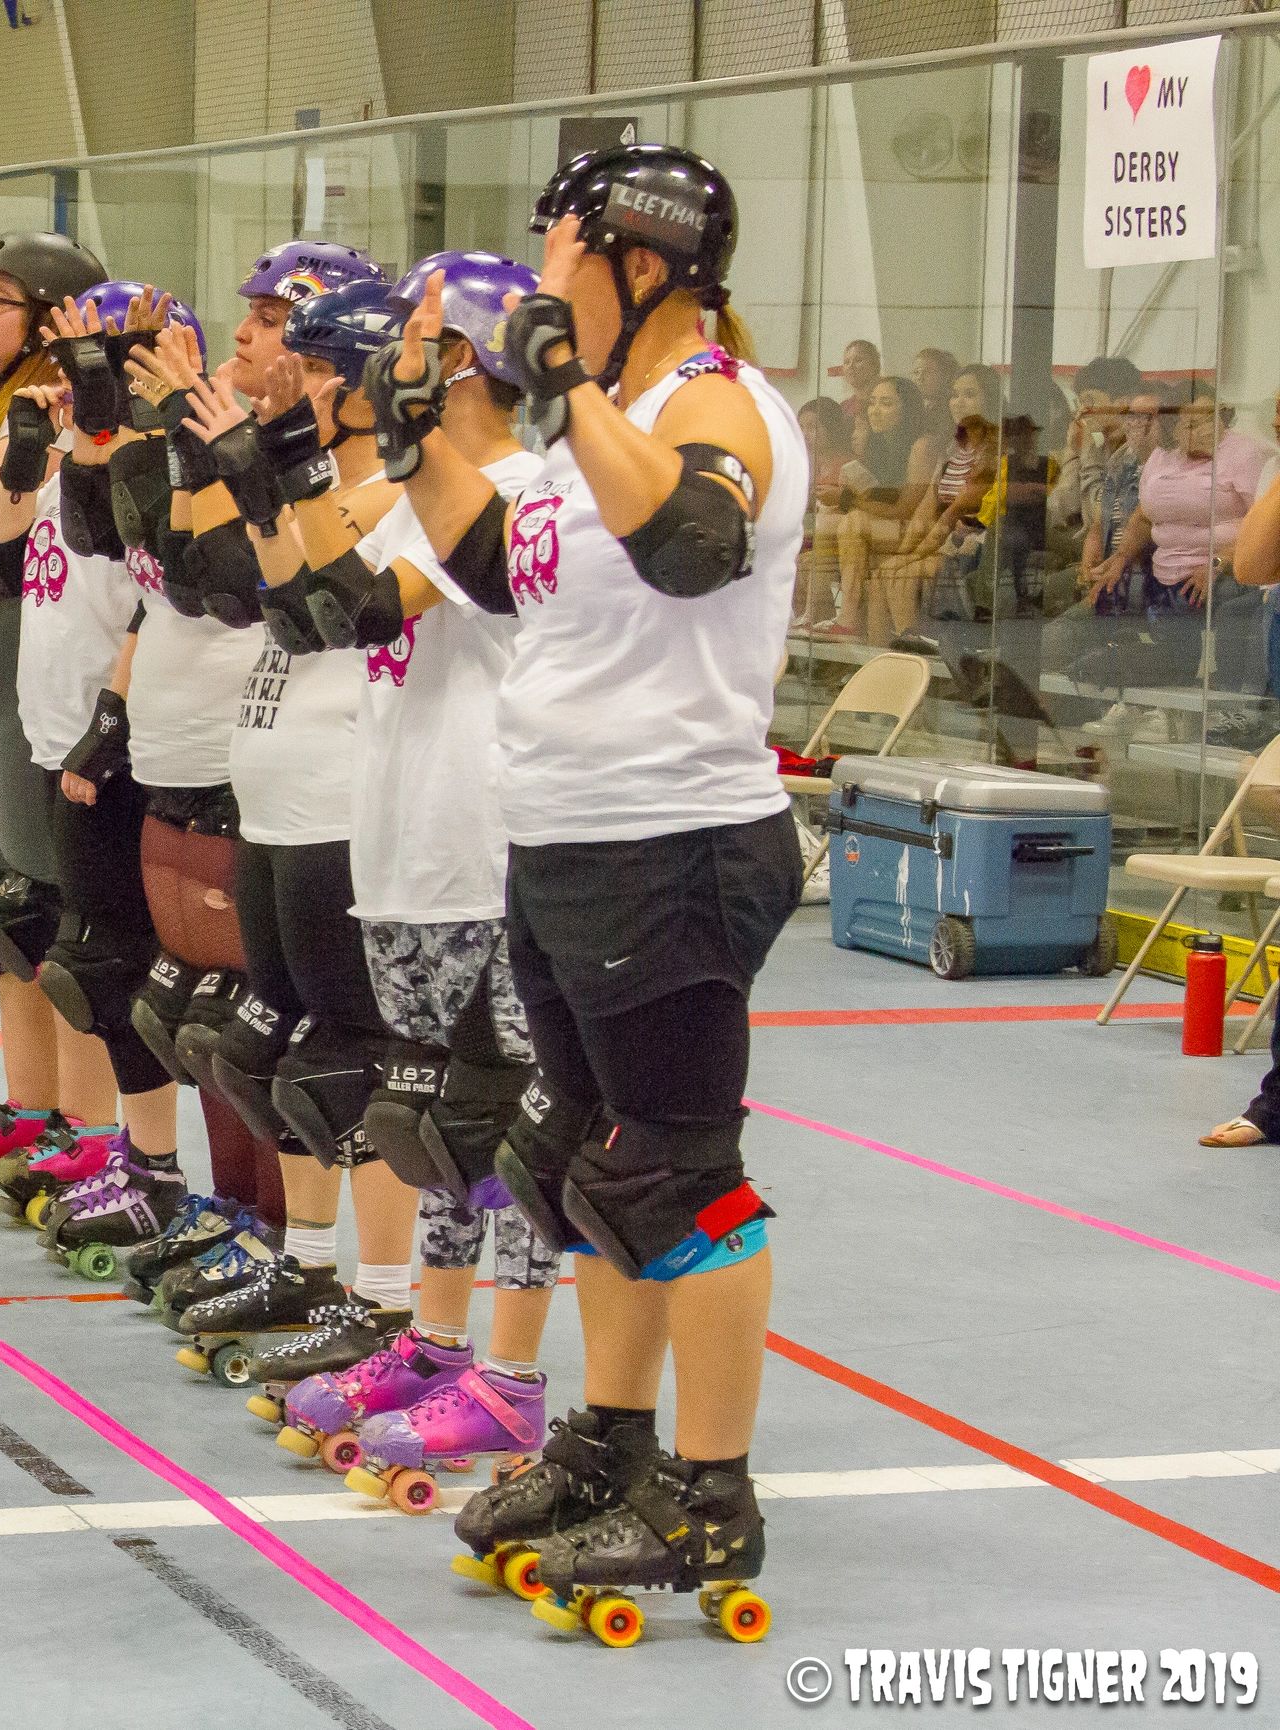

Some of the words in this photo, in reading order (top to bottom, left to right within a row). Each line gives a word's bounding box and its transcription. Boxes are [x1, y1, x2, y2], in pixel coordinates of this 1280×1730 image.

[1103, 81, 1108, 111] I
[1157, 75, 1189, 109] MY
[1114, 150, 1179, 183] DERBY
[1104, 204, 1187, 238] SISTERS
[154, 959, 180, 979] 187
[243, 994, 279, 1023] 187
[390, 1066, 436, 1082] 187
[526, 1081, 551, 1110] 187
